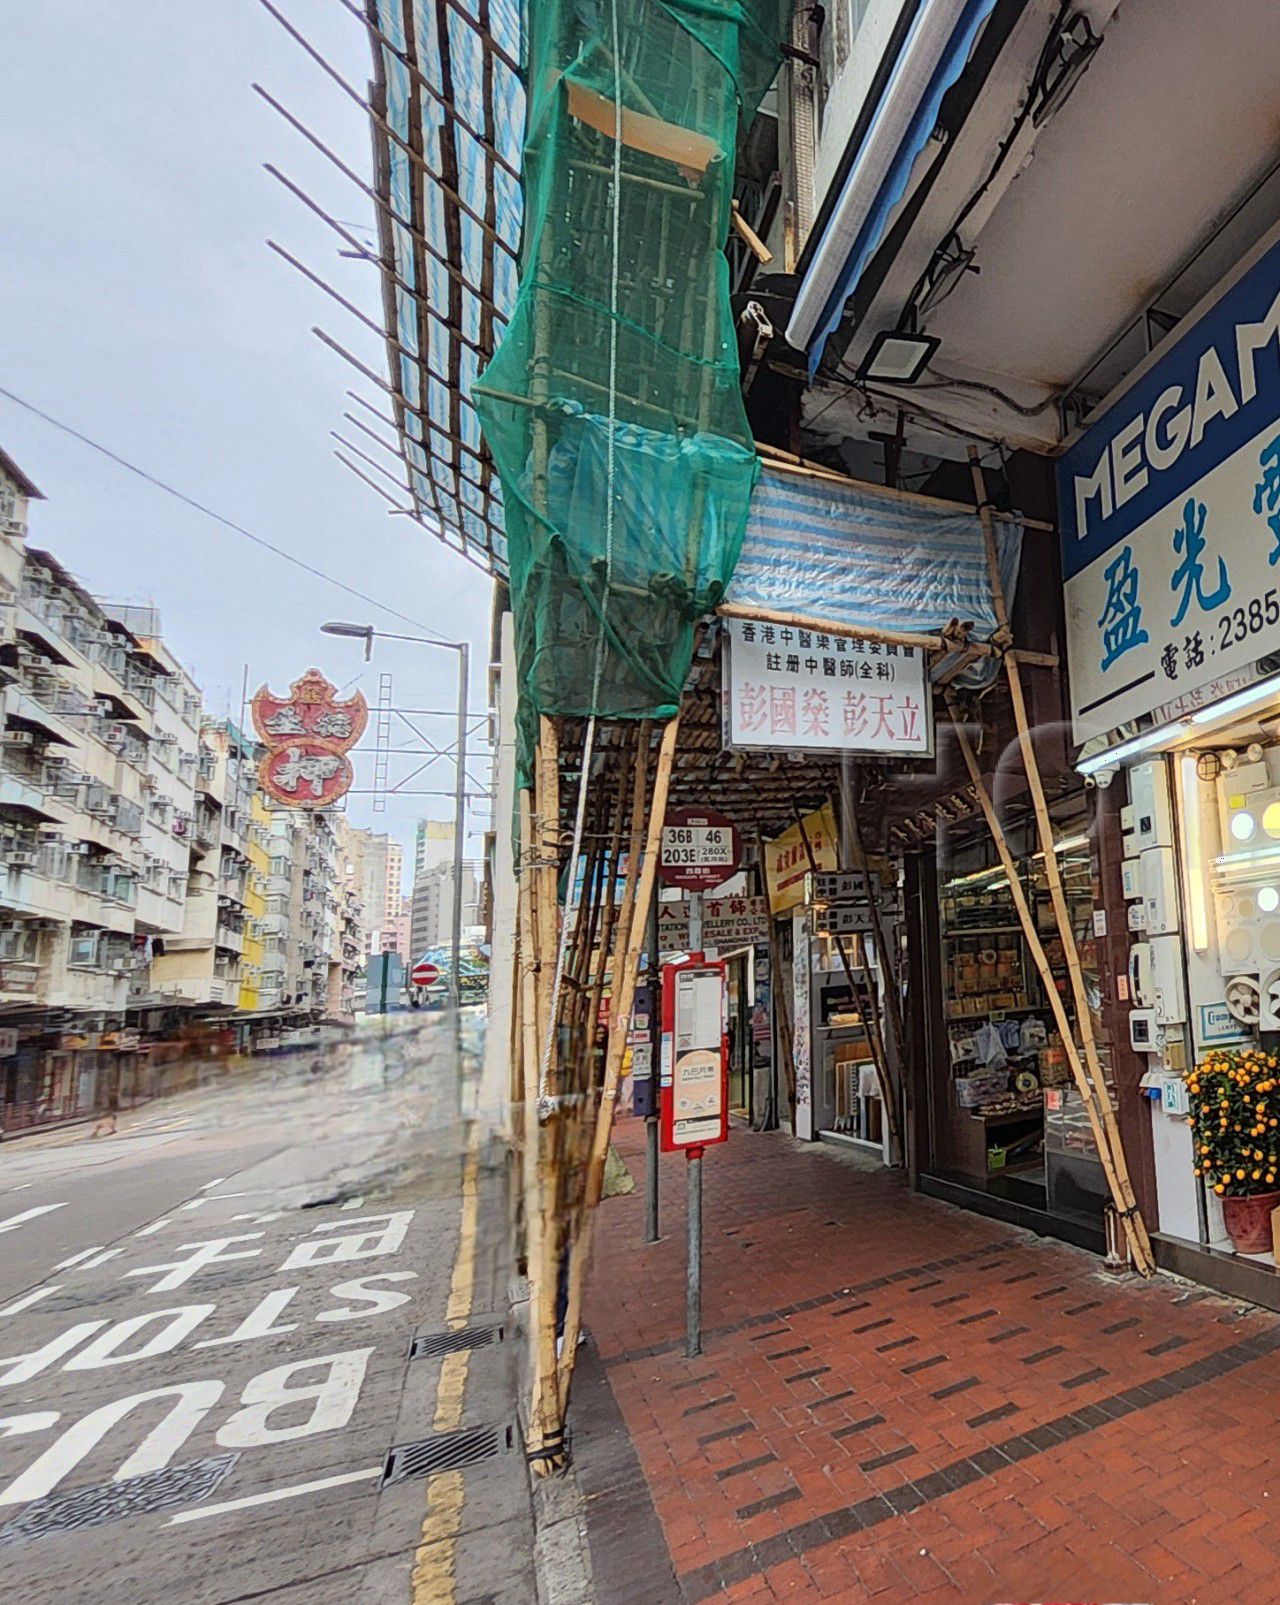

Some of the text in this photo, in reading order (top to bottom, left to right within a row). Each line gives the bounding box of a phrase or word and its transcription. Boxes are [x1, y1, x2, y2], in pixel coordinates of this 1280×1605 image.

[1218, 588, 1280, 651] 2385
[668, 829, 722, 844] 36B 46
[664, 848, 697, 863] 203E
[1208, 1011, 1231, 1025] Crom
[0, 1347, 376, 1504] BU
